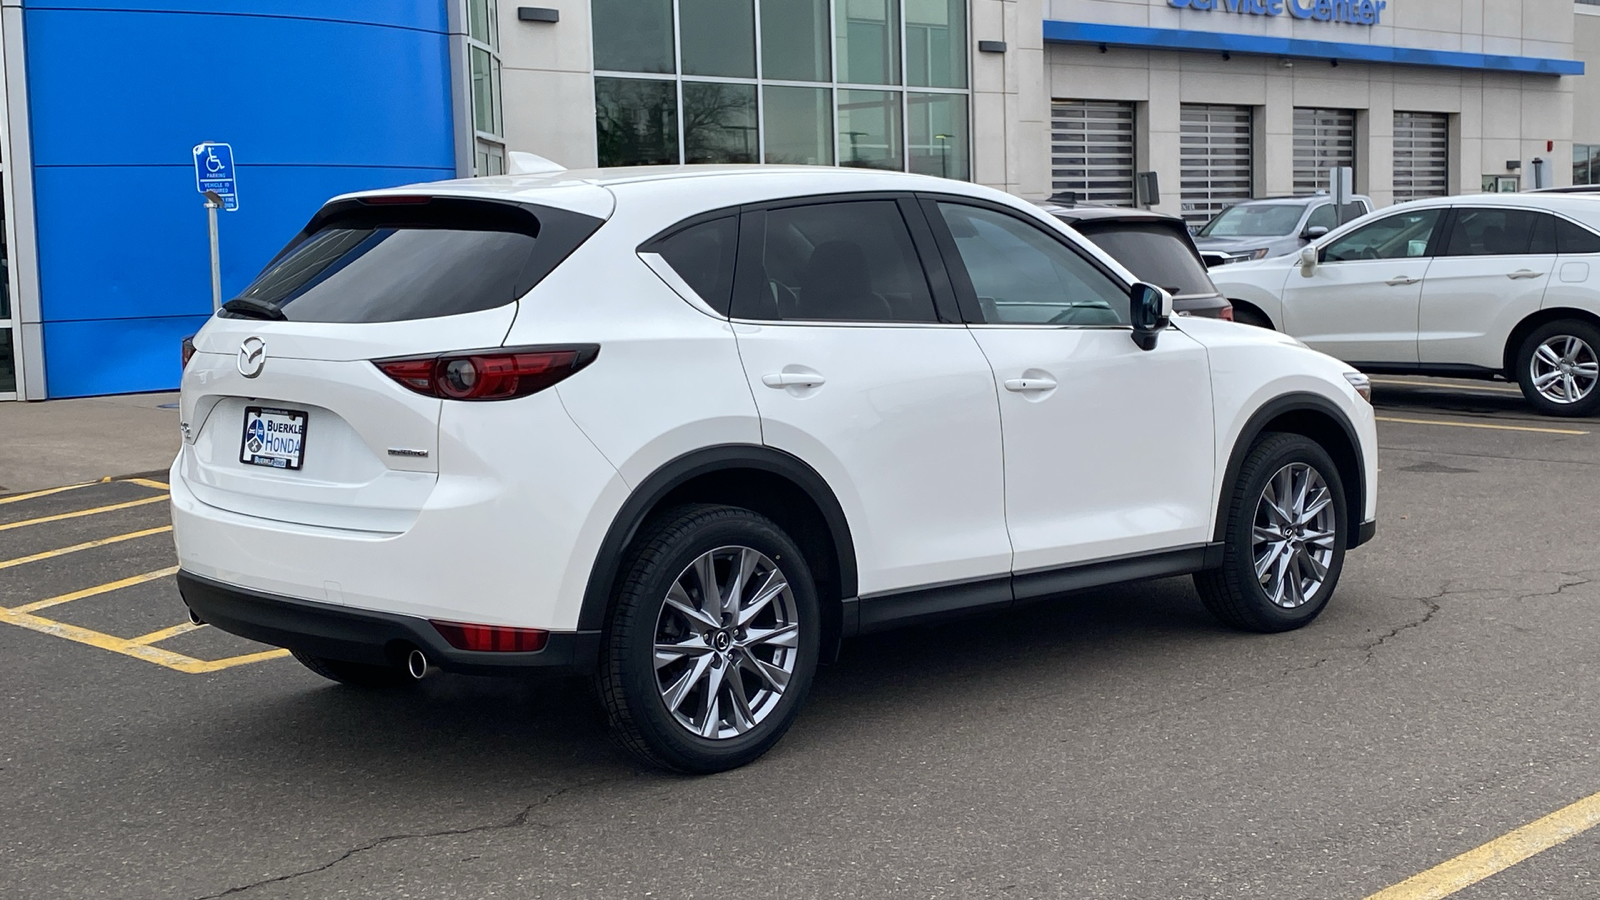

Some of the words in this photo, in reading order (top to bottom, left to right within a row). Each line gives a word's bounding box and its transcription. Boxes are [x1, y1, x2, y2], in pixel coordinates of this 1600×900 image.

[1286, 0, 1387, 25] Center
[267, 420, 303, 434] BUERKLE
[265, 432, 300, 453] HONDA
